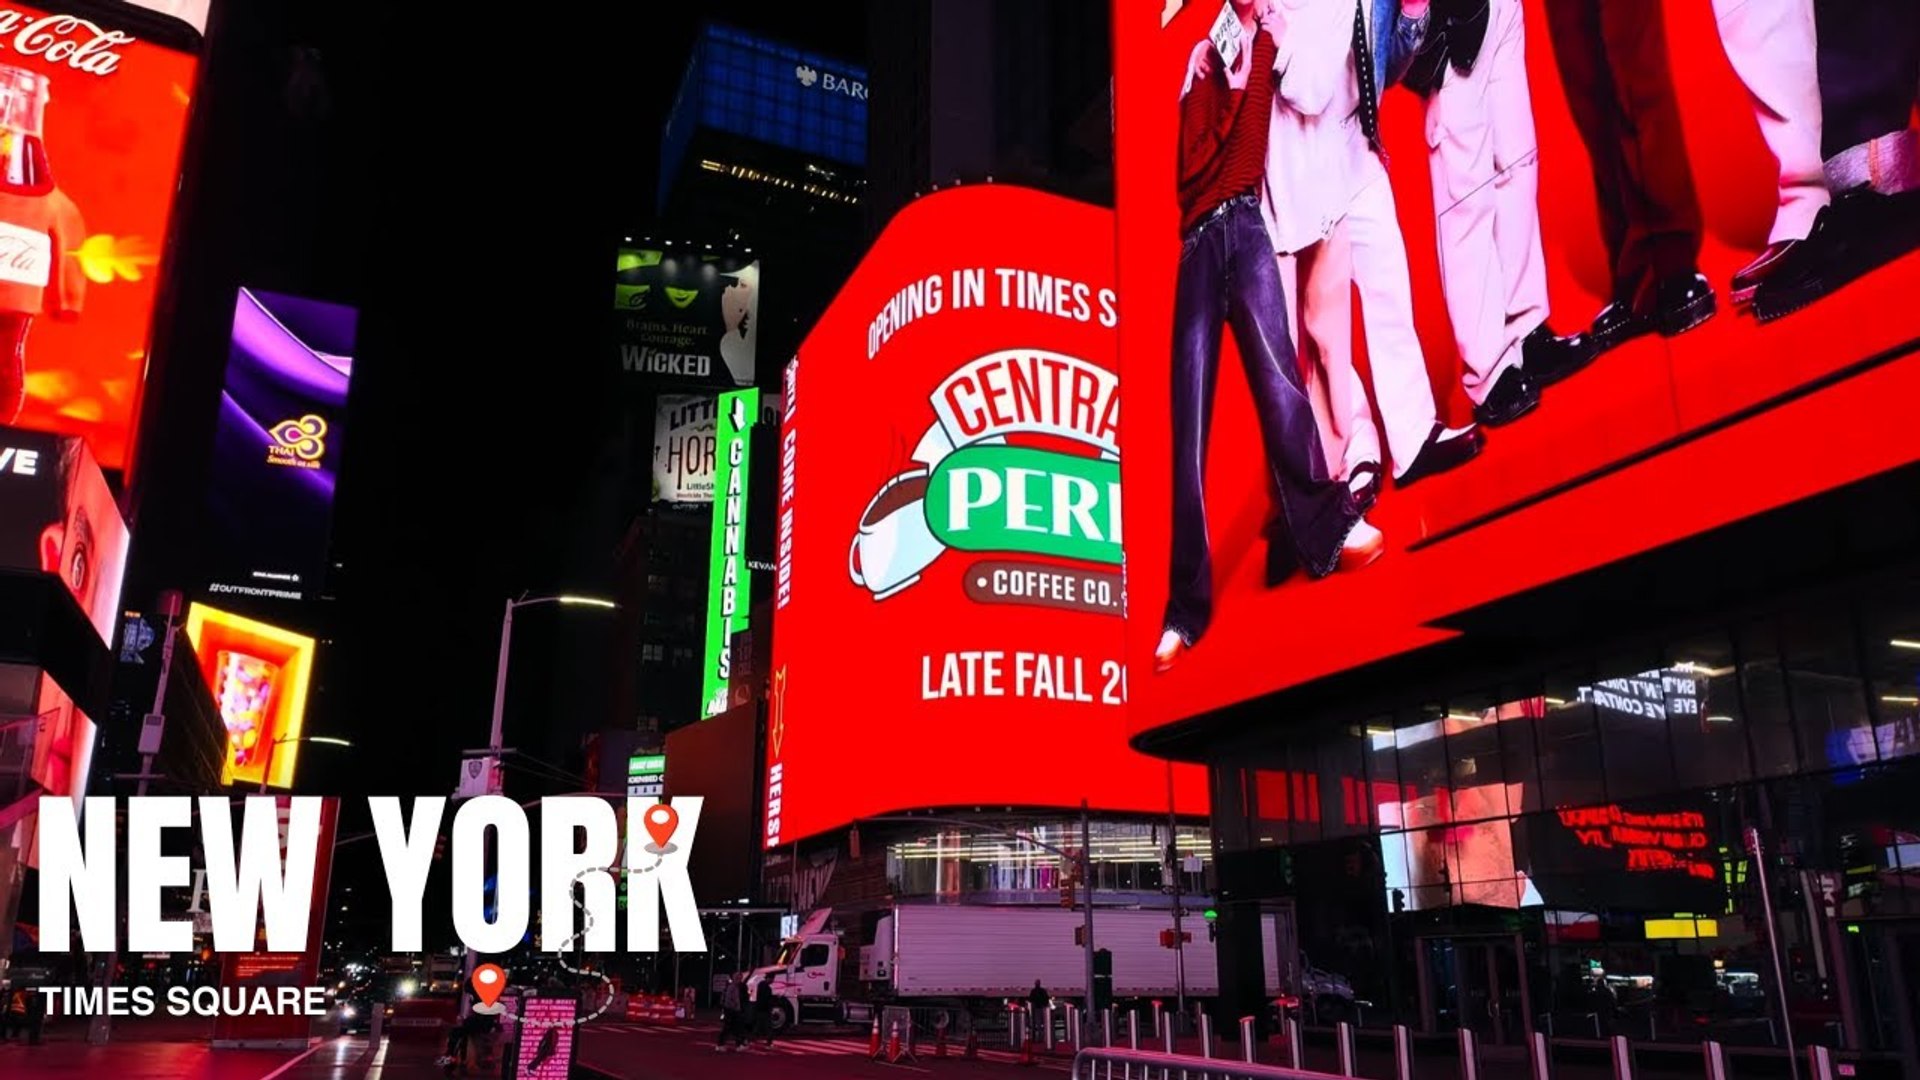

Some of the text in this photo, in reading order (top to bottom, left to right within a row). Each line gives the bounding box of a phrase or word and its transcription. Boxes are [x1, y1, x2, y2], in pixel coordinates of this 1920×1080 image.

[822, 73, 869, 100] BAR
[866, 274, 942, 360] OPENING
[952, 268, 985, 309] IN
[995, 268, 1090, 323] TIMES
[782, 428, 796, 507] COME
[718, 438, 744, 680] CANNABIS
[777, 507, 794, 610] INSIDE!
[993, 569, 1076, 602] COFFEE
[1083, 580, 1118, 606] CO.
[922, 651, 1004, 702] LATE
[1015, 652, 1093, 703] FALL
